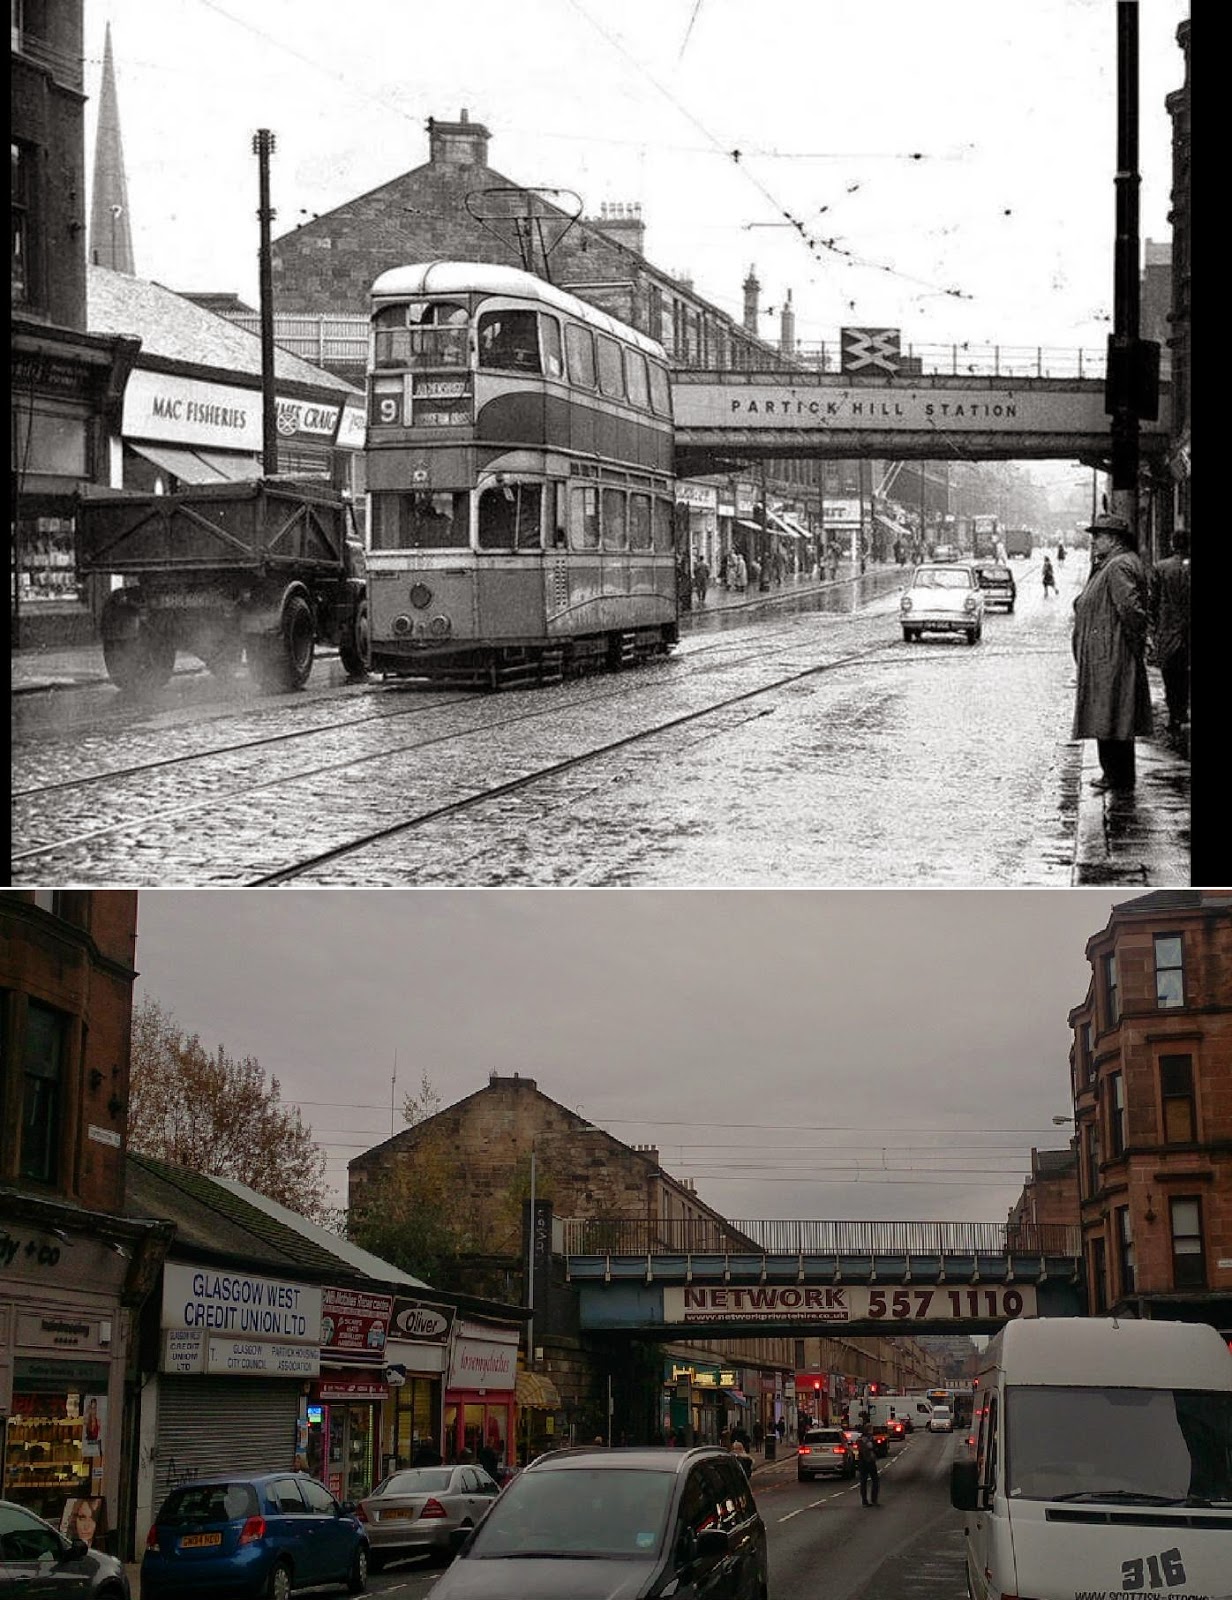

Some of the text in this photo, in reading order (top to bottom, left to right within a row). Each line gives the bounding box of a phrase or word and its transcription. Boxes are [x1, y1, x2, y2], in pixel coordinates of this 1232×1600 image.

[152, 396, 247, 430] MAC FISHERIES
[381, 399, 396, 422] 9
[731, 400, 1017, 417] PARTICK HILL STATION
[193, 1274, 300, 1310] GLASGOW WEST
[684, 1288, 1023, 1318] NETWORK 557 1110
[184, 1302, 306, 1336] CREDIT UNION LTD
[406, 1311, 438, 1333] Oliver
[687, 1312, 847, 1321] www.networkprivatehire.co.uk
[170, 1342, 200, 1350] CREDIT
[233, 1344, 263, 1355] GLASGOW
[172, 1353, 198, 1361] UNION
[227, 1358, 267, 1370] CITY COUNCIL
[176, 1363, 191, 1371] LTD
[278, 1360, 312, 1372] ASSOCIATION
[1121, 1547, 1187, 1591] 316
